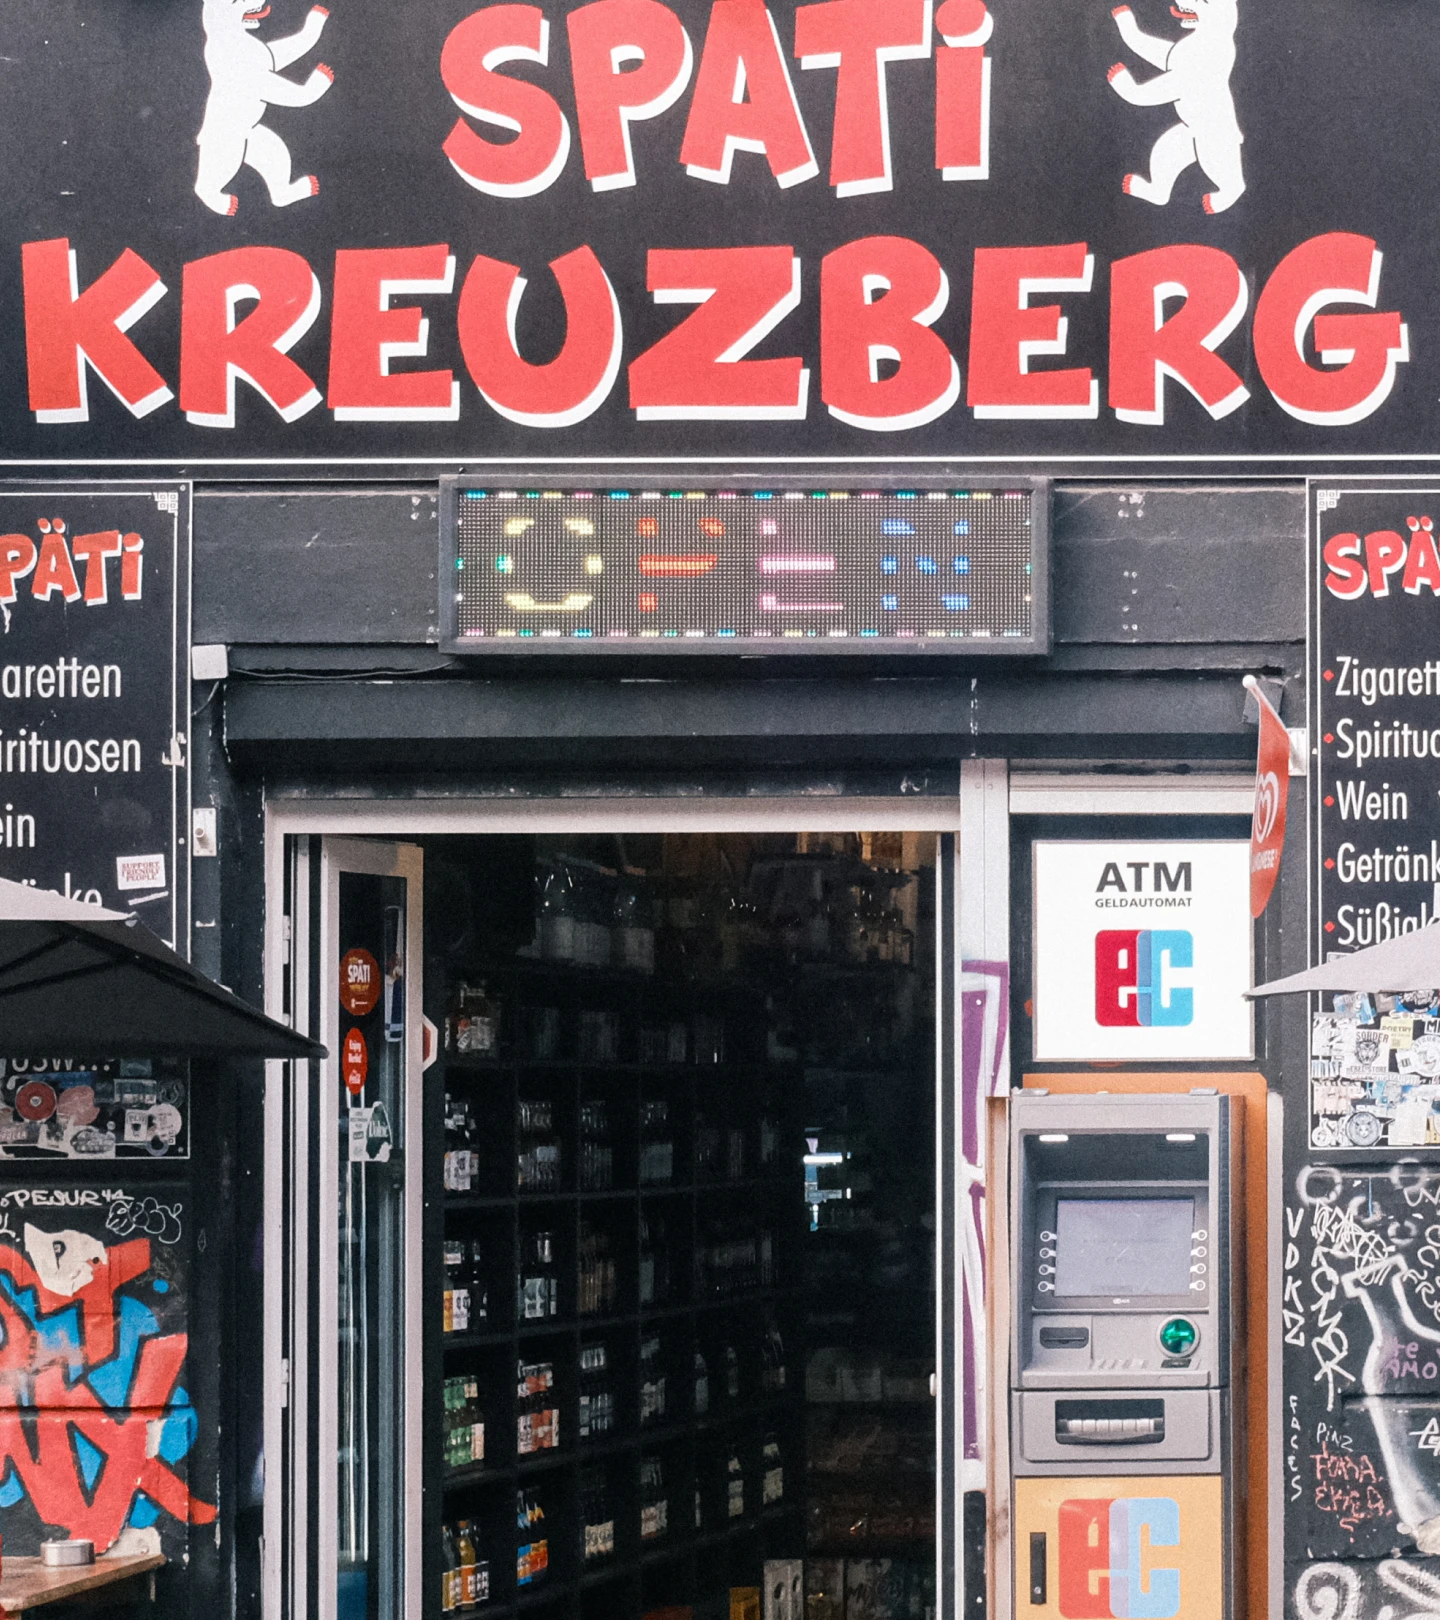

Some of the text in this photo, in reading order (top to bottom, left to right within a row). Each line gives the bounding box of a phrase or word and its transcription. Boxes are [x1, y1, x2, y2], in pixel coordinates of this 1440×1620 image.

[22, 232, 1410, 428] KREUZBERG
[1336, 780, 1408, 821] Wein
[1095, 862, 1193, 893] ATM
[1095, 897, 1193, 908] GELDAUTOMAT
